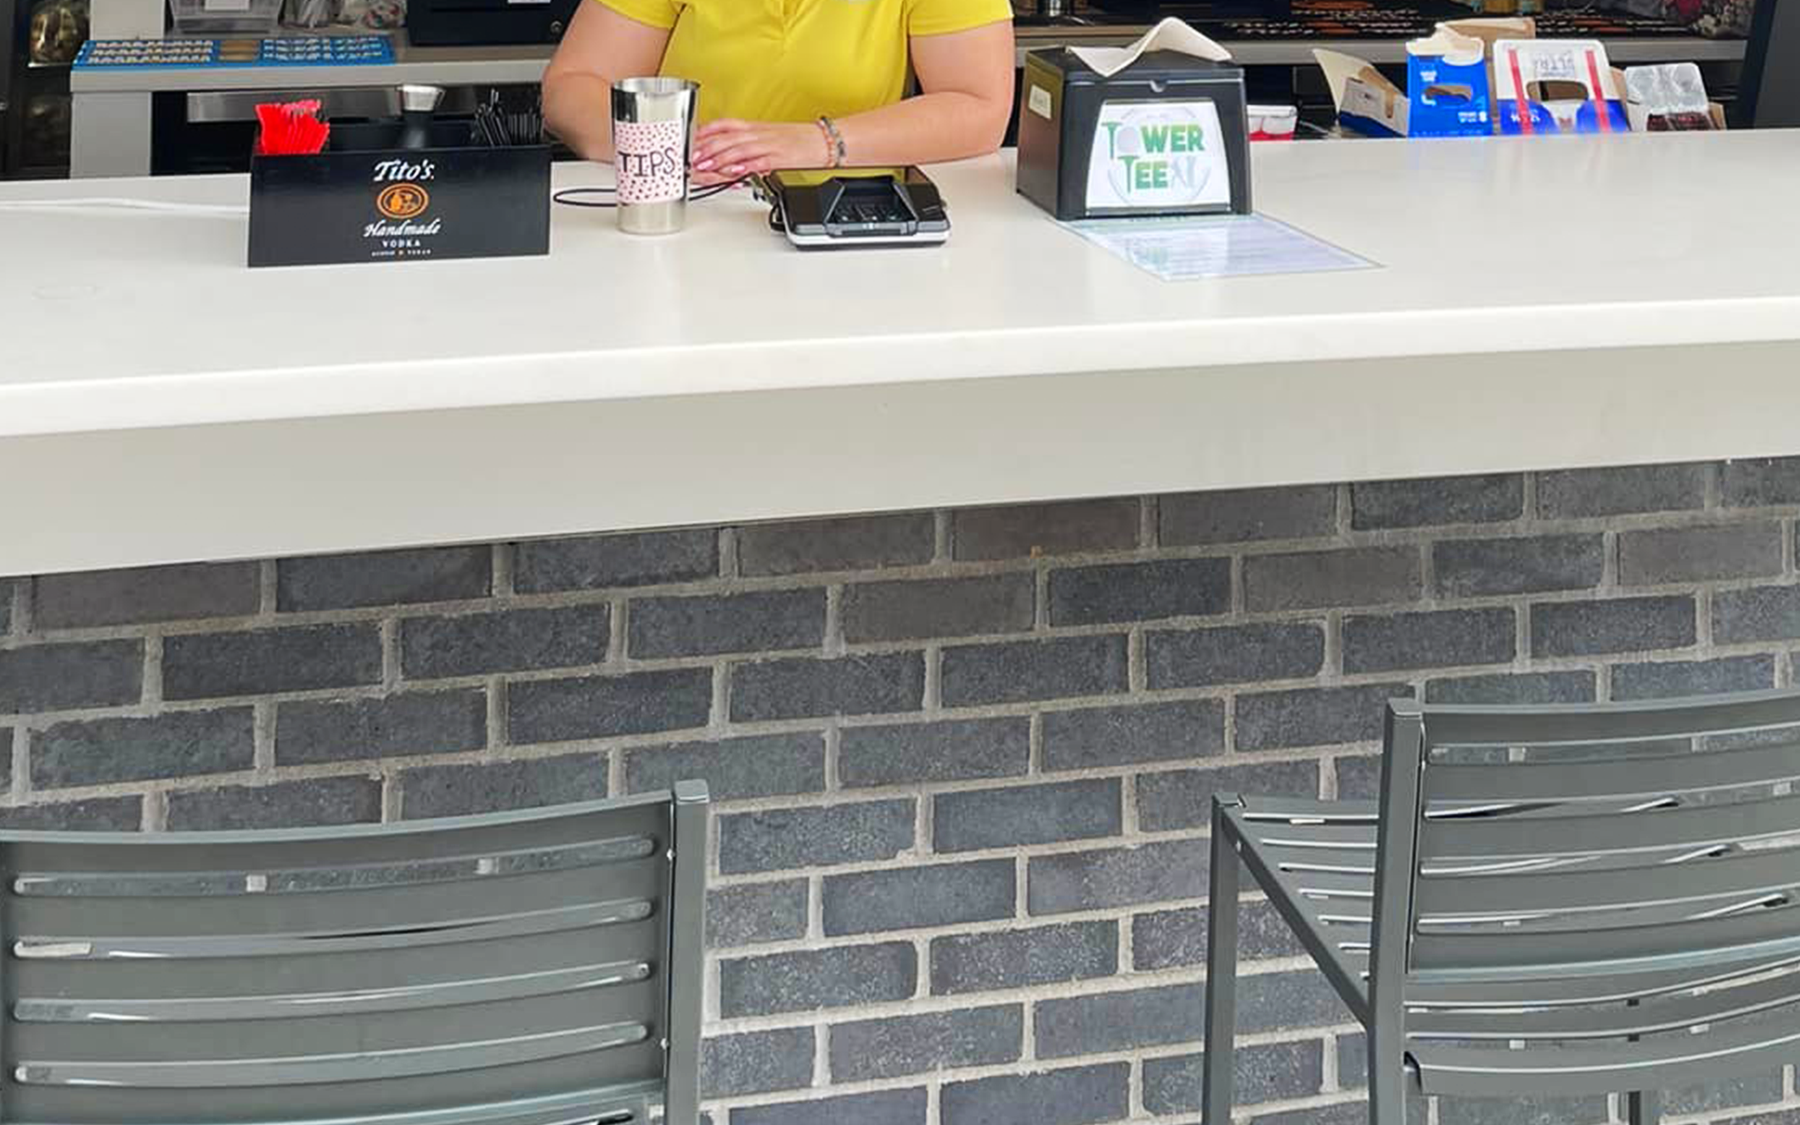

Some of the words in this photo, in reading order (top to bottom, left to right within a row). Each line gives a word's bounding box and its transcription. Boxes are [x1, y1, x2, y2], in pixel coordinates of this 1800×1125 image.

[373, 159, 435, 181] Tito's
[618, 148, 676, 177] TIPS
[364, 218, 442, 237] Handmade
[382, 239, 422, 248] VODKA
